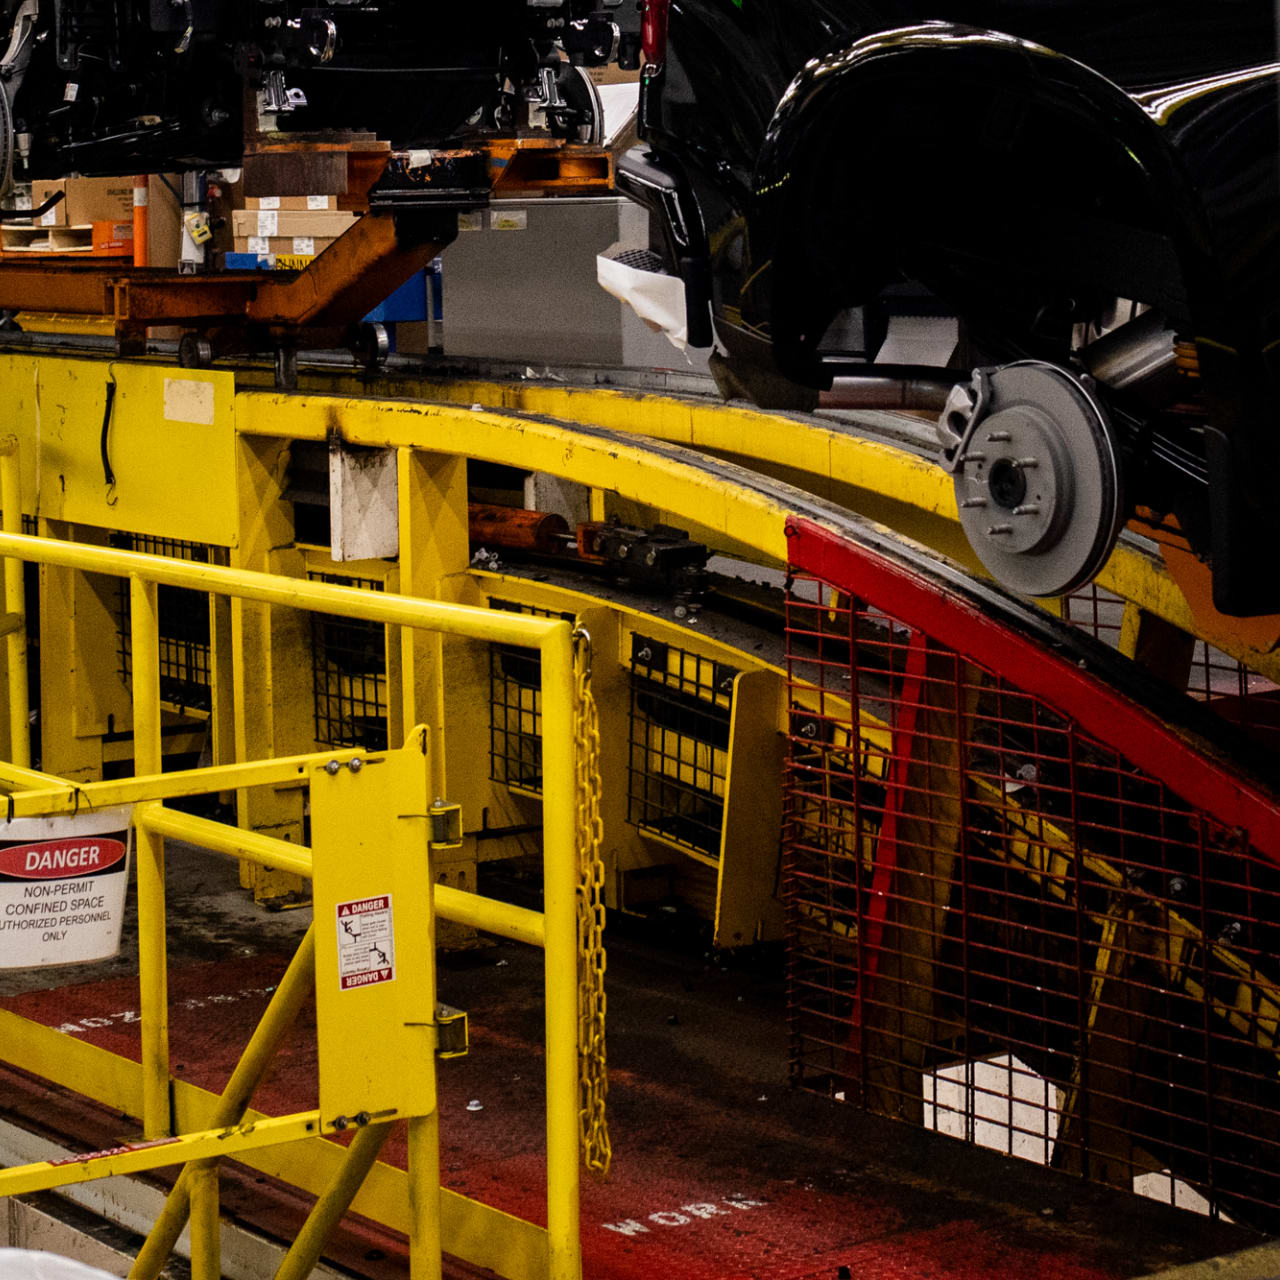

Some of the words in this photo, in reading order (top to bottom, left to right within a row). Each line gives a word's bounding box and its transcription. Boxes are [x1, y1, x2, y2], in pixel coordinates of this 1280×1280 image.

[25, 846, 100, 871] DANGER
[24, 880, 95, 898] NON-PERMIT
[5, 901, 68, 916] CONFINED
[70, 896, 105, 910] SPACE
[351, 899, 385, 914] DANGER
[59, 910, 111, 926] PERSONNEL
[42, 930, 68, 943] ONLY
[346, 971, 379, 986] DANGER
